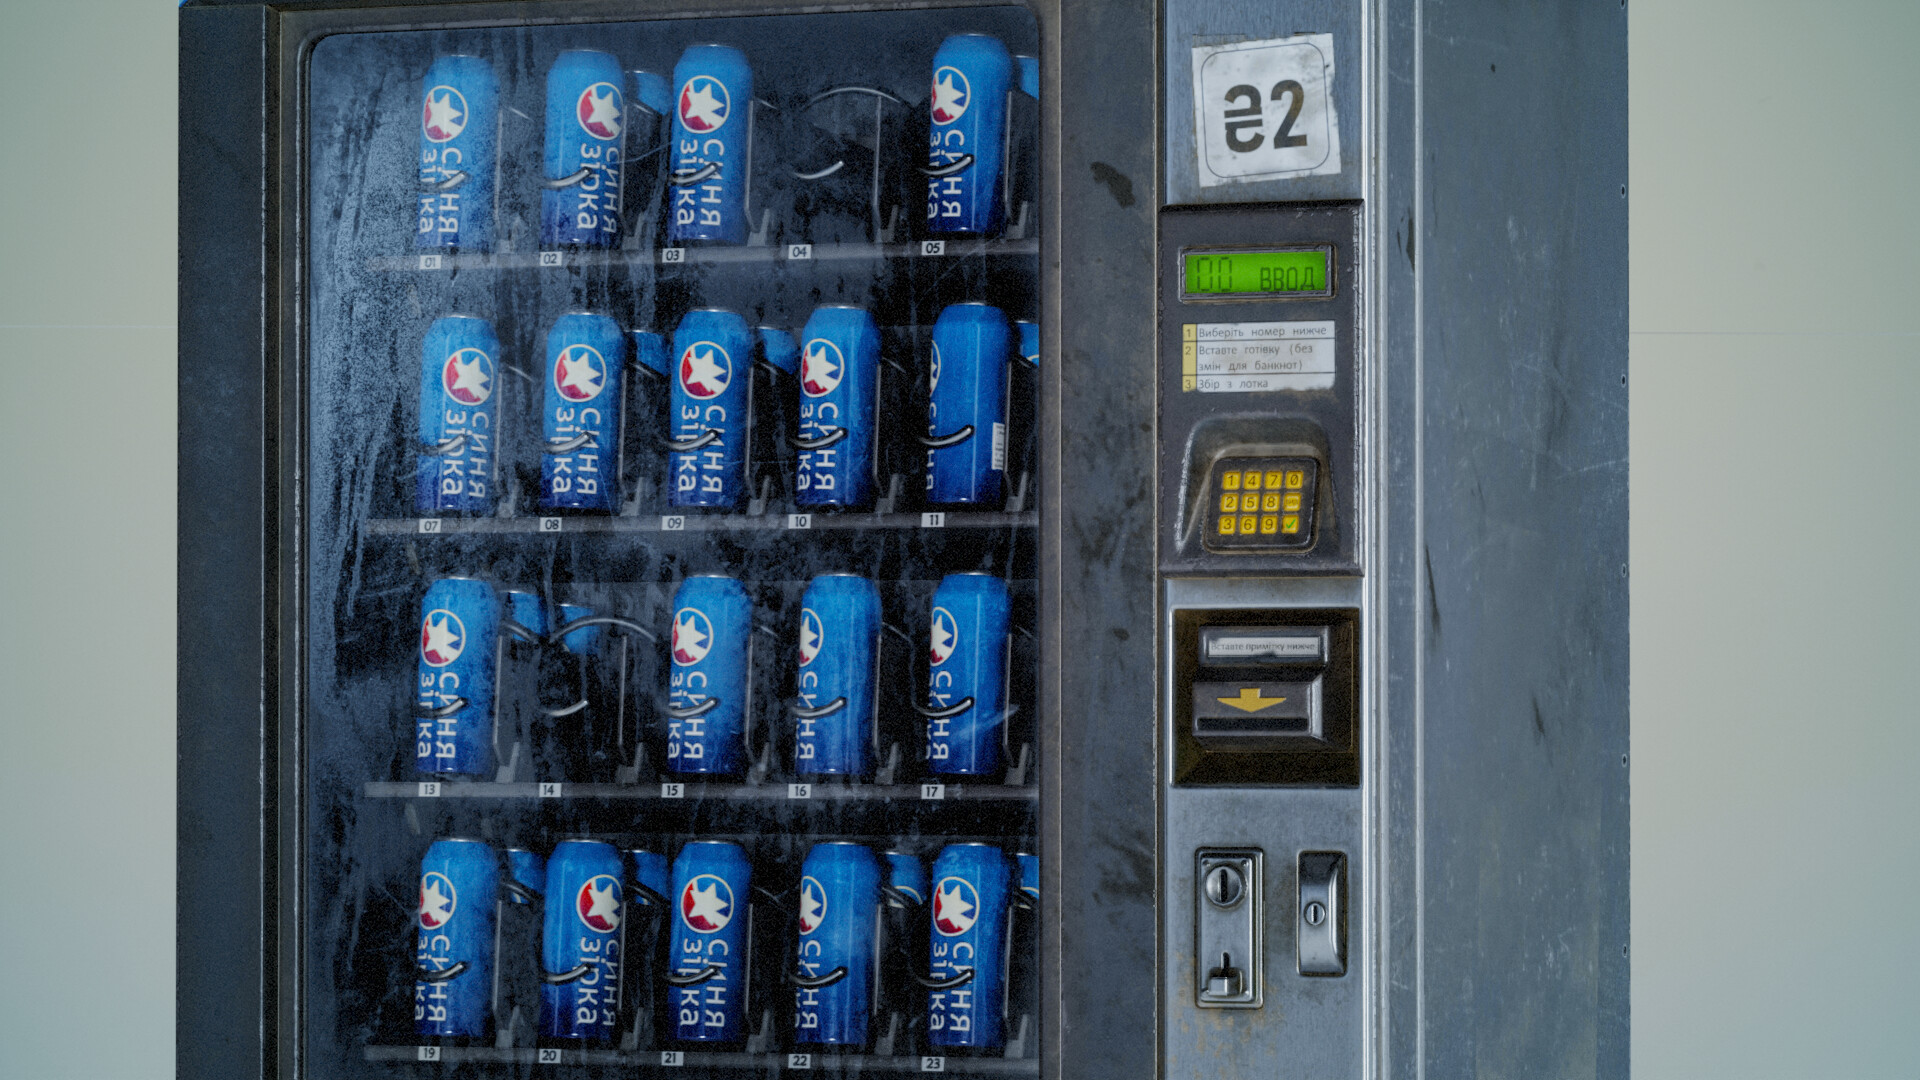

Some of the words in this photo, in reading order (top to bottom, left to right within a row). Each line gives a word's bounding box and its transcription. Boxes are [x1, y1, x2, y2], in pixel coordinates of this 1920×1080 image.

[927, 132, 945, 219] зіка
[792, 247, 807, 257] 04
[926, 243, 940, 253] 05
[543, 254, 557, 264] 02
[666, 250, 680, 261] 03
[425, 257, 436, 267] 01
[1197, 257, 1232, 292] 00
[1260, 267, 1315, 291] ВВОД
[1199, 327, 1243, 340] Виберіть
[1252, 328, 1285, 339] номер
[1293, 327, 1327, 336] нижче
[1199, 346, 1237, 355] Вставте
[1245, 344, 1280, 356] готівку
[1289, 343, 1313, 355] (без
[1199, 361, 1221, 371] змін
[1228, 361, 1247, 372] для
[1255, 359, 1303, 371] банкнот)
[1199, 379, 1220, 390] Збір
[1239, 380, 1268, 389] лотка
[1228, 475, 1235, 486] 1
[1247, 475, 1256, 486] 4
[1269, 475, 1277, 486] 7
[1290, 475, 1299, 486] 0
[1226, 496, 1233, 507] 2
[1247, 496, 1255, 507] 5
[1267, 496, 1275, 507] 8
[545, 519, 559, 530] 08
[667, 517, 682, 528] 09
[795, 516, 807, 527] 10
[929, 515, 939, 525] 11
[1223, 519, 1232, 530] 3
[1244, 519, 1252, 530] 6
[1265, 519, 1273, 530] 9
[424, 521, 437, 531] 07
[424, 785, 435, 794] 13
[543, 785, 554, 795] 14
[667, 785, 678, 796] 15
[795, 786, 807, 796] 16
[926, 786, 938, 797] 17
[415, 936, 432, 1021] зіка
[424, 1048, 435, 1058] 19
[541, 1051, 556, 1061] 20
[664, 1052, 676, 1063] 21
[792, 1055, 807, 1066] 22
[926, 1058, 940, 1069] 23
